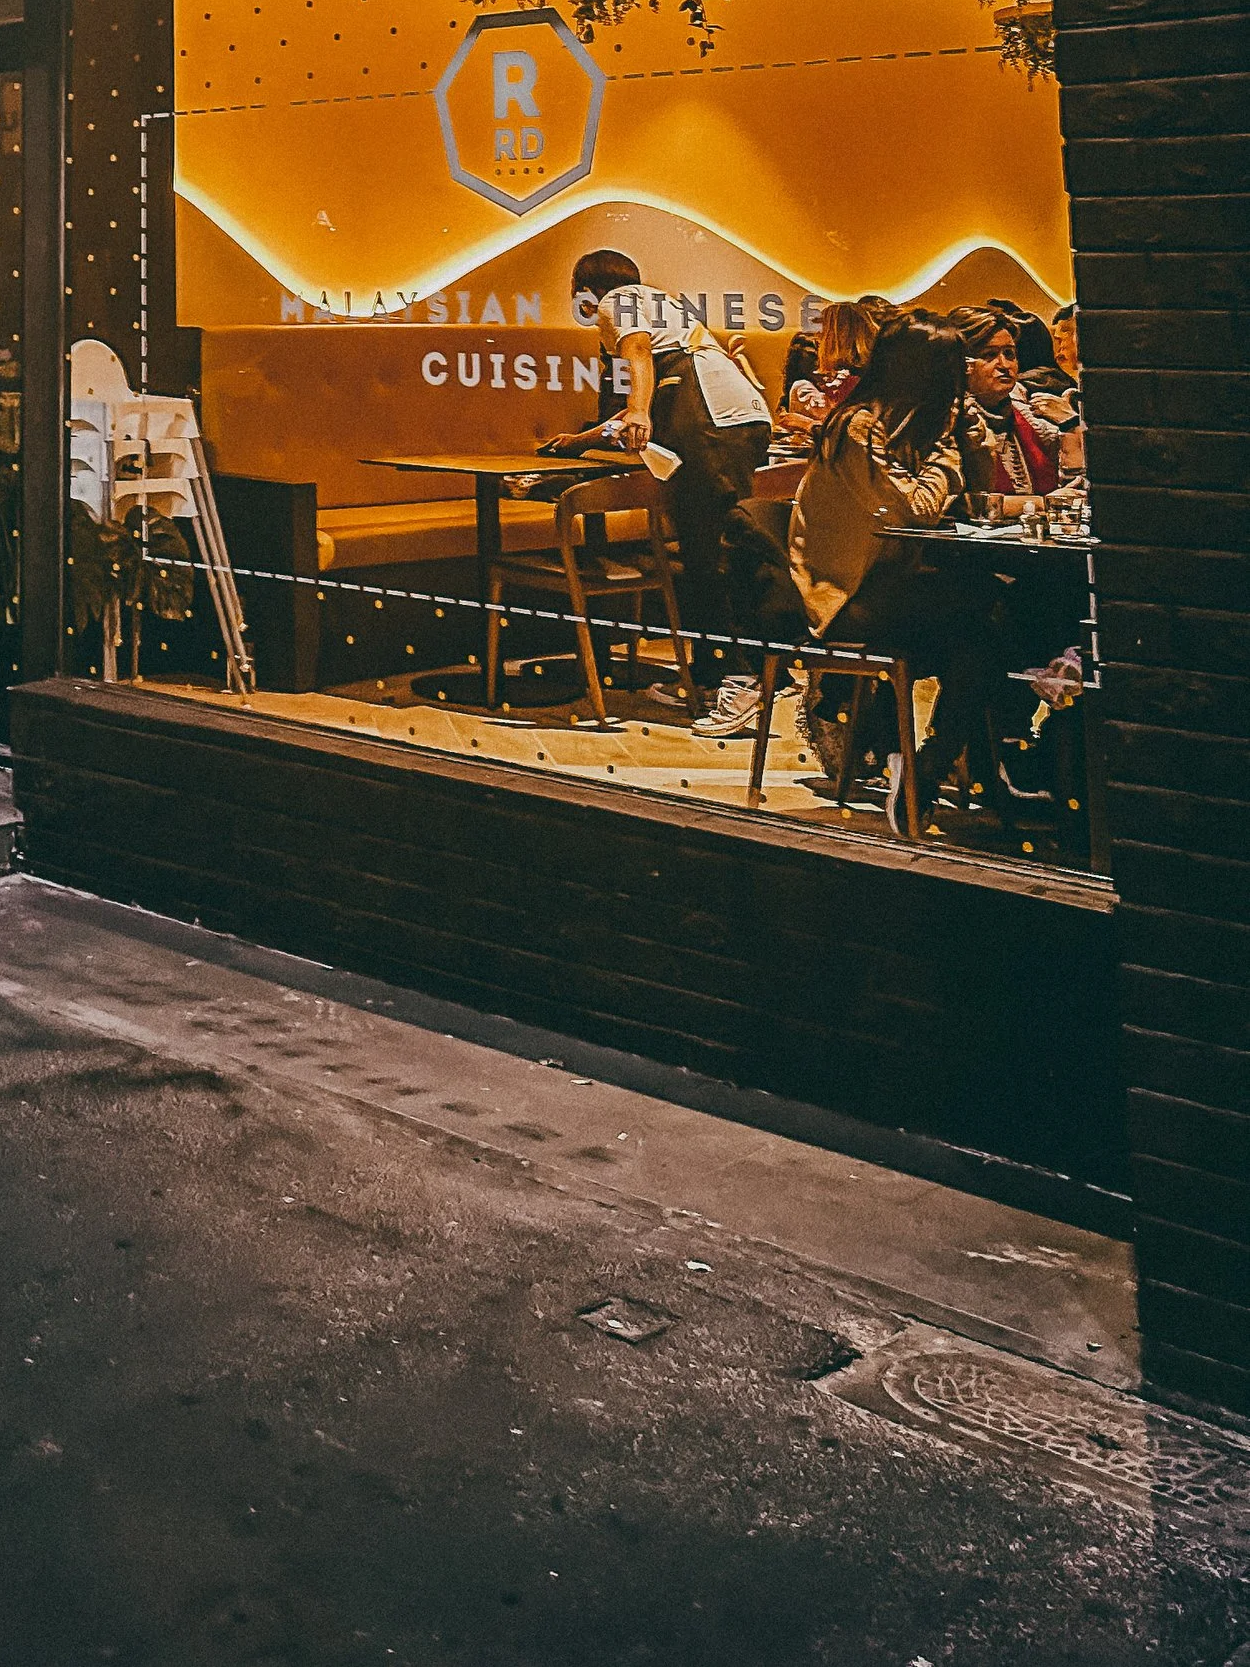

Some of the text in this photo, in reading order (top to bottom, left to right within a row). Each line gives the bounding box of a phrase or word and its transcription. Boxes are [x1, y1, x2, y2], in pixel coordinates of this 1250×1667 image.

[492, 50, 541, 120] R
[494, 127, 545, 162] RD
[280, 290, 826, 332] MALAYSIAN CHINESE
[422, 351, 633, 395] CUISINE
